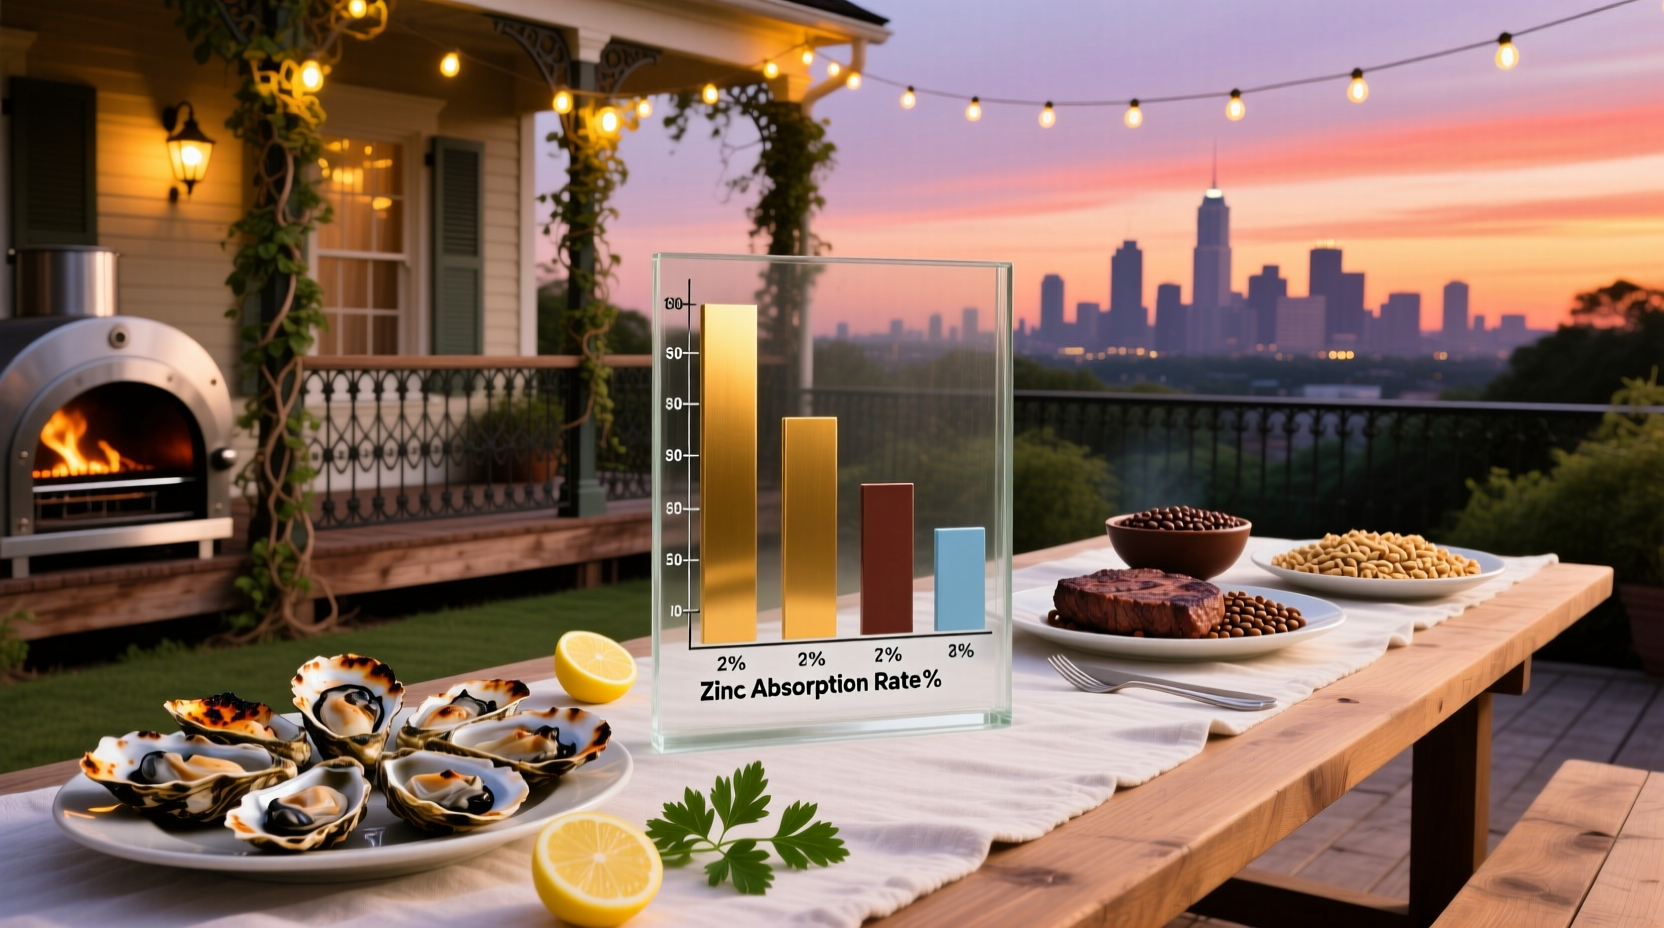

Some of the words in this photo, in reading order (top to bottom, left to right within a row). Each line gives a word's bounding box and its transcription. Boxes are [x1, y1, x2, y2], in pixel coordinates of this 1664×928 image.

[670, 604, 682, 617] 10
[717, 655, 746, 671] 2%
[874, 646, 903, 662] 2%
[700, 680, 746, 701] Zinc
[750, 673, 868, 700] Absorption
